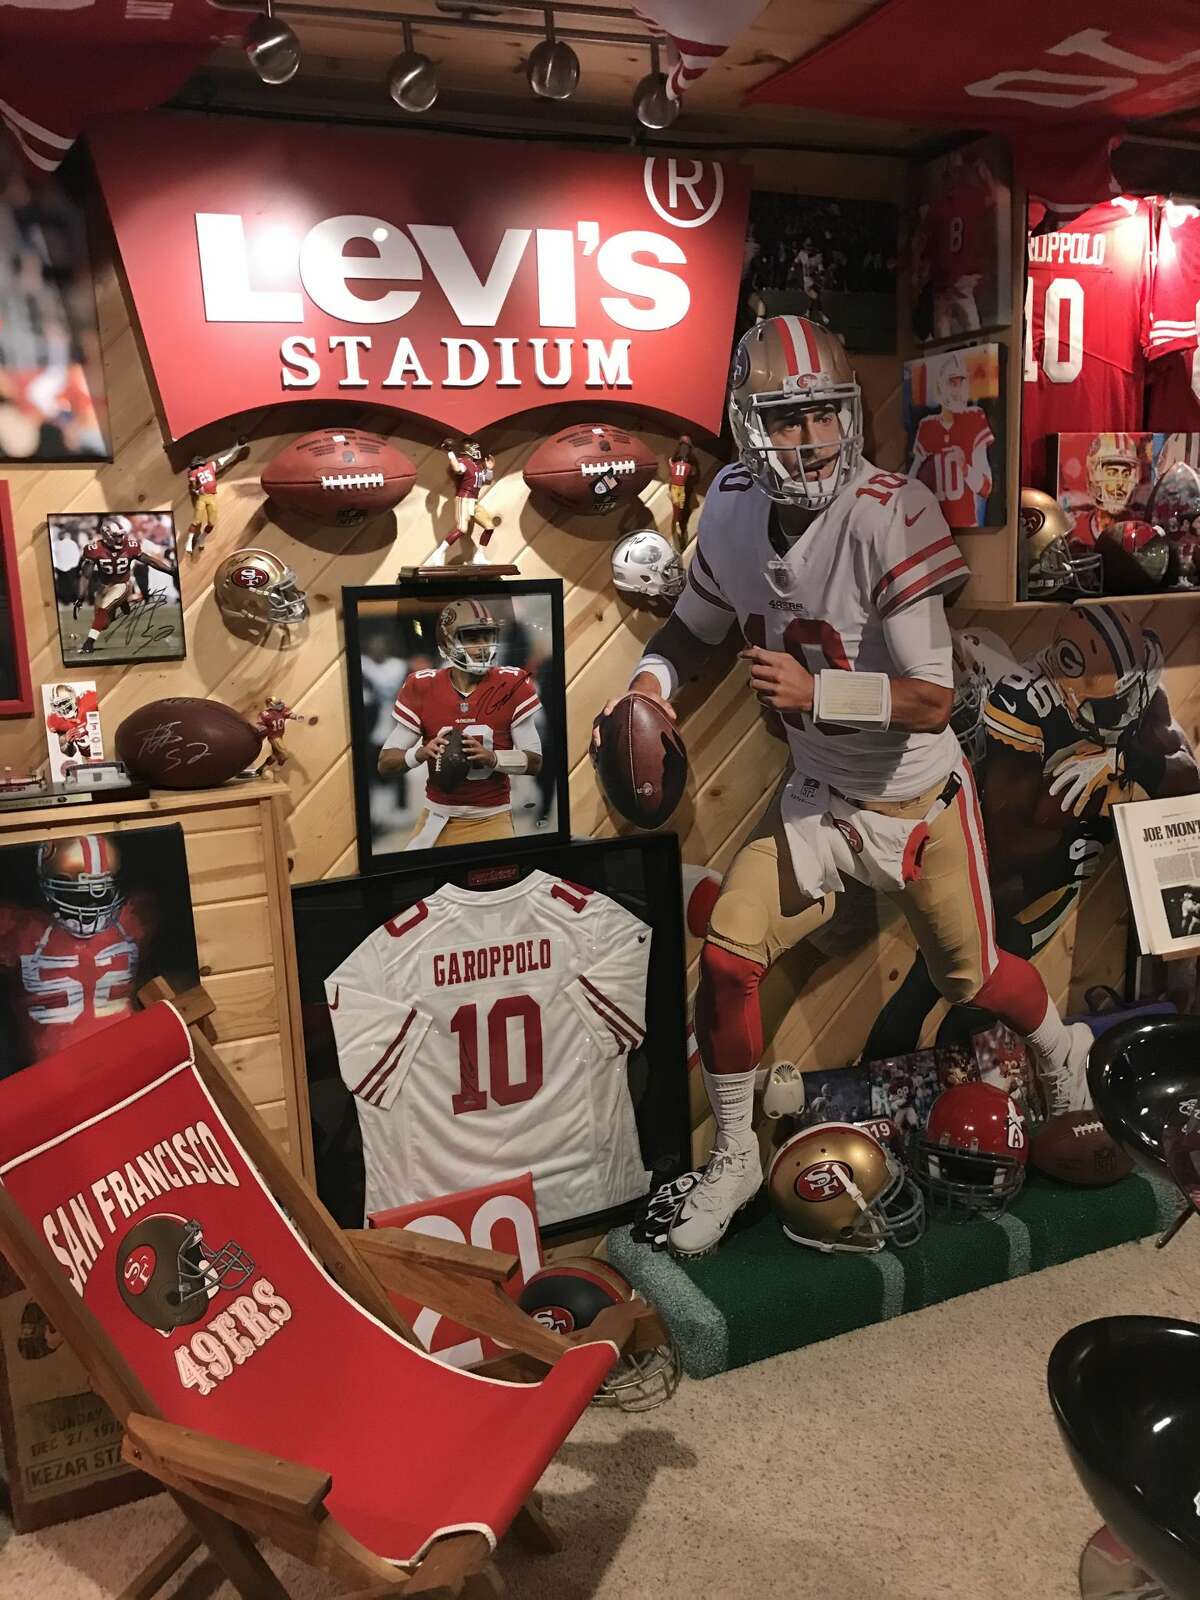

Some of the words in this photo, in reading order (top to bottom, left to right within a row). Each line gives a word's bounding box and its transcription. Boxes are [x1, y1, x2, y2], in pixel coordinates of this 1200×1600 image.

[280, 336, 634, 389] STADIUM
[856, 473, 908, 506] 10
[935, 444, 965, 501] 10
[99, 557, 129, 575] 52
[271, 719, 285, 732] 10
[1143, 826, 1164, 843] JOE
[20, 937, 139, 1024] 52
[433, 938, 552, 987] GAROPPOLO
[450, 994, 544, 1115] 10
[42, 1192, 104, 1299] SAN
[90, 1120, 240, 1234] FRANCISCO
[174, 1276, 293, 1396] 49ERS
[30, 1456, 89, 1487] KEZAR
